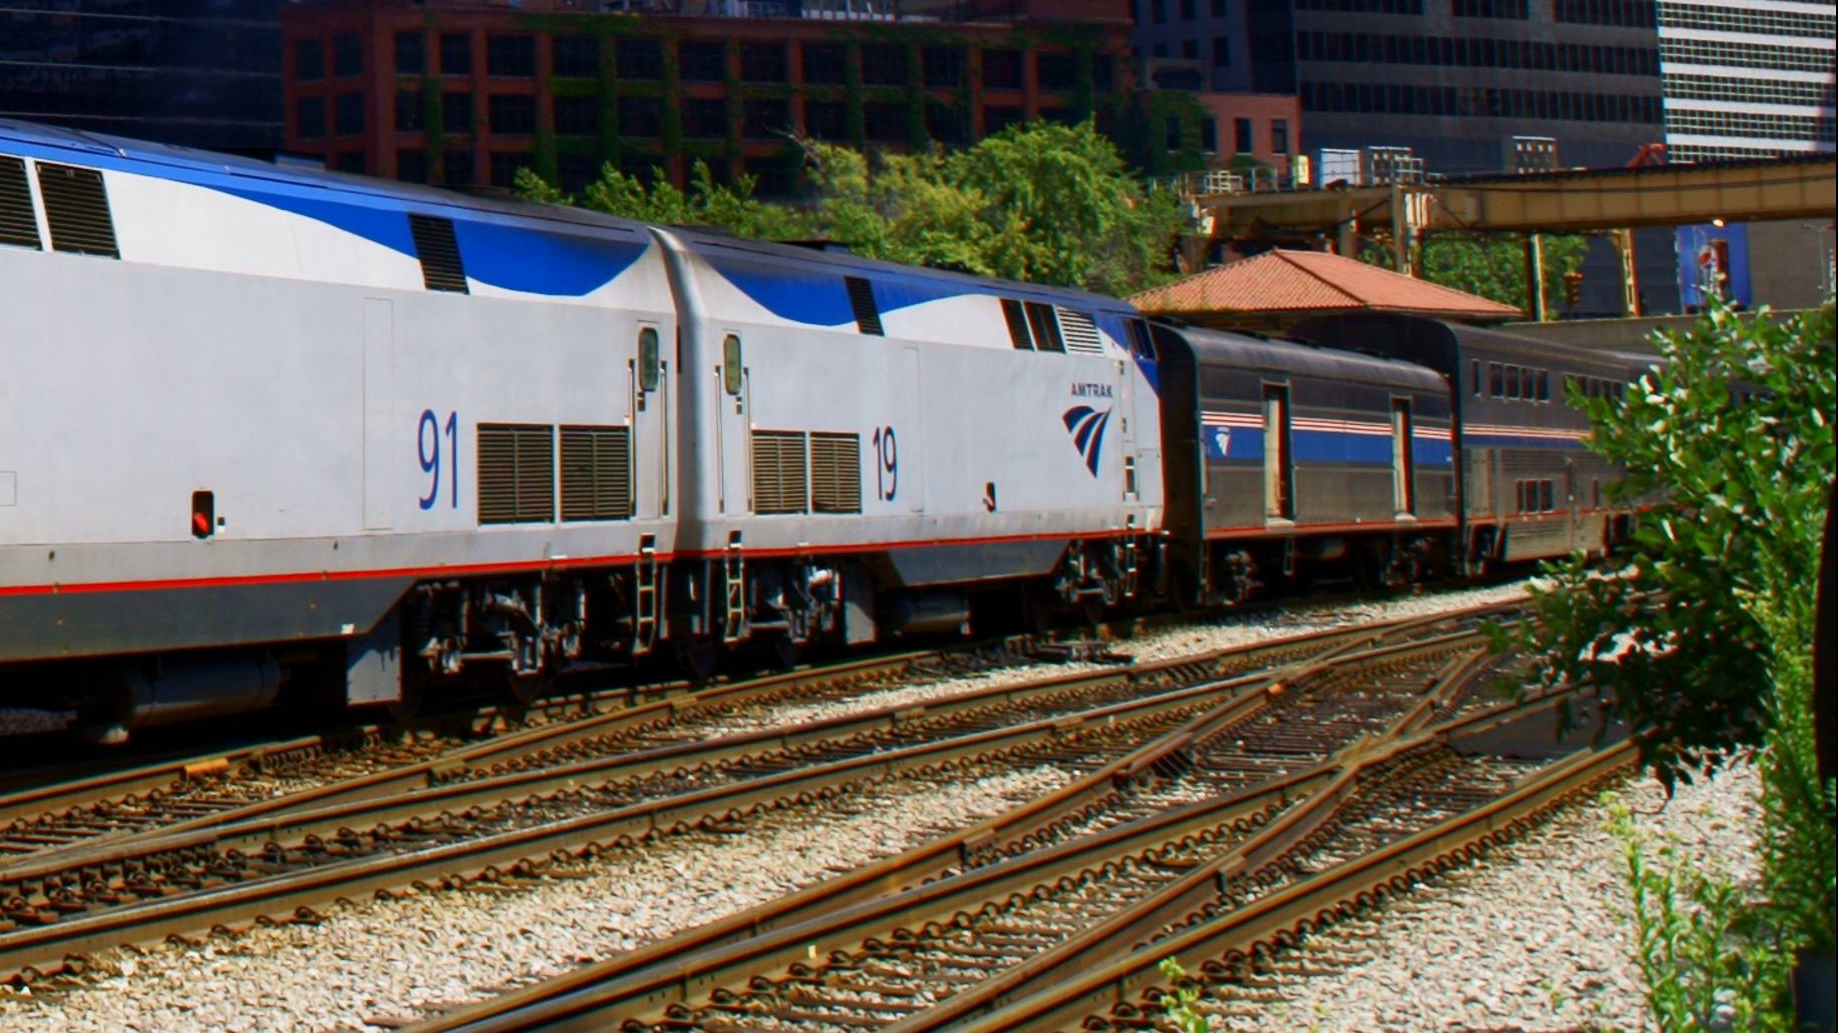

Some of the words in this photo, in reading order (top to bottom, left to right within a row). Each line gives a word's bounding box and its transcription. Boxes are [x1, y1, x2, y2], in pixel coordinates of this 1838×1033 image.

[1071, 382, 1114, 399] AMTRAK
[418, 409, 458, 510] 91
[872, 426, 898, 502] 19
